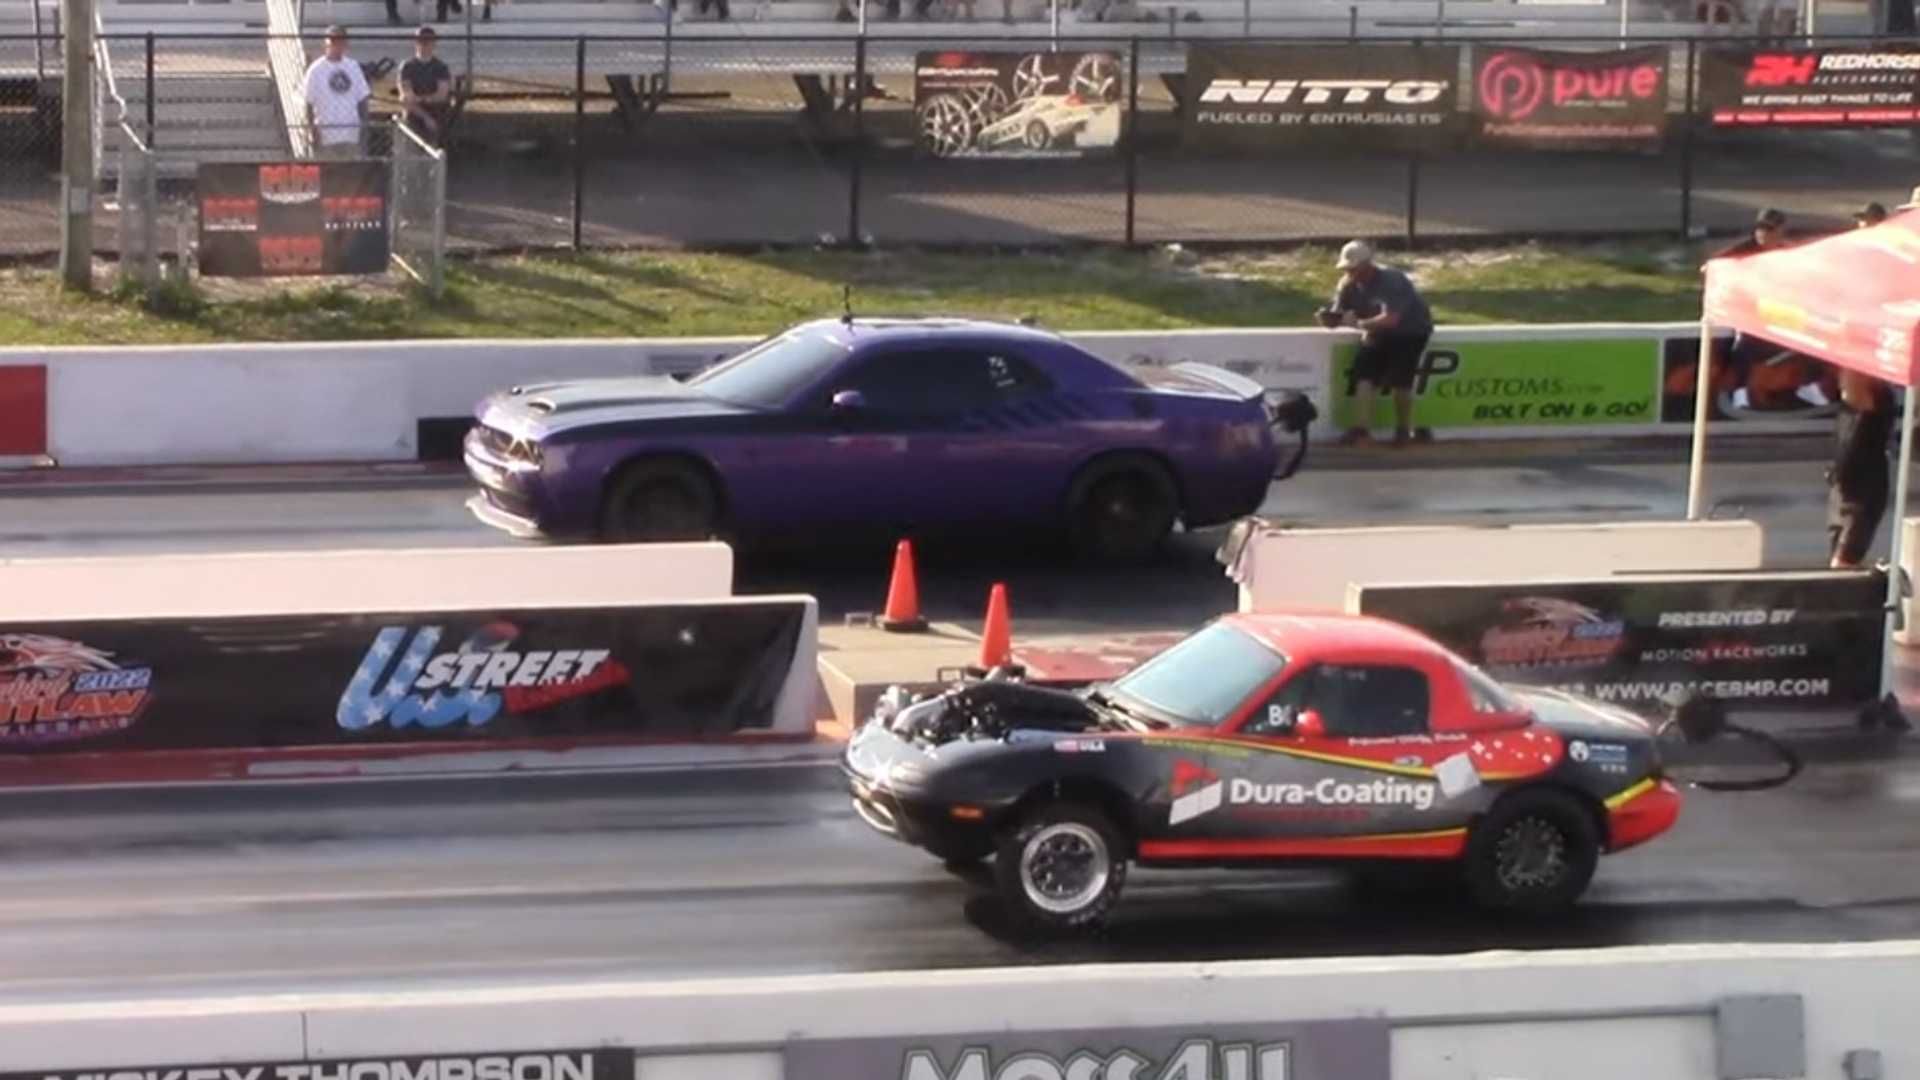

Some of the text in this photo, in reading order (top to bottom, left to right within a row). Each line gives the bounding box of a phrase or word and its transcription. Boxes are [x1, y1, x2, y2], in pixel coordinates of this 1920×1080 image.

[1200, 79, 1447, 103] NITTO
[1554, 66, 1658, 106] pure
[1197, 111, 1444, 125] FUELED BY ENTHUSIASTS
[1473, 402, 1533, 419] BOLT
[1539, 402, 1575, 417] ON
[1658, 609, 1796, 628] PRESENTED BY
[1640, 645, 1808, 661] MOTION RACEWORKS
[414, 650, 609, 688] STREET
[1231, 778, 1435, 808] Dura-Coating
